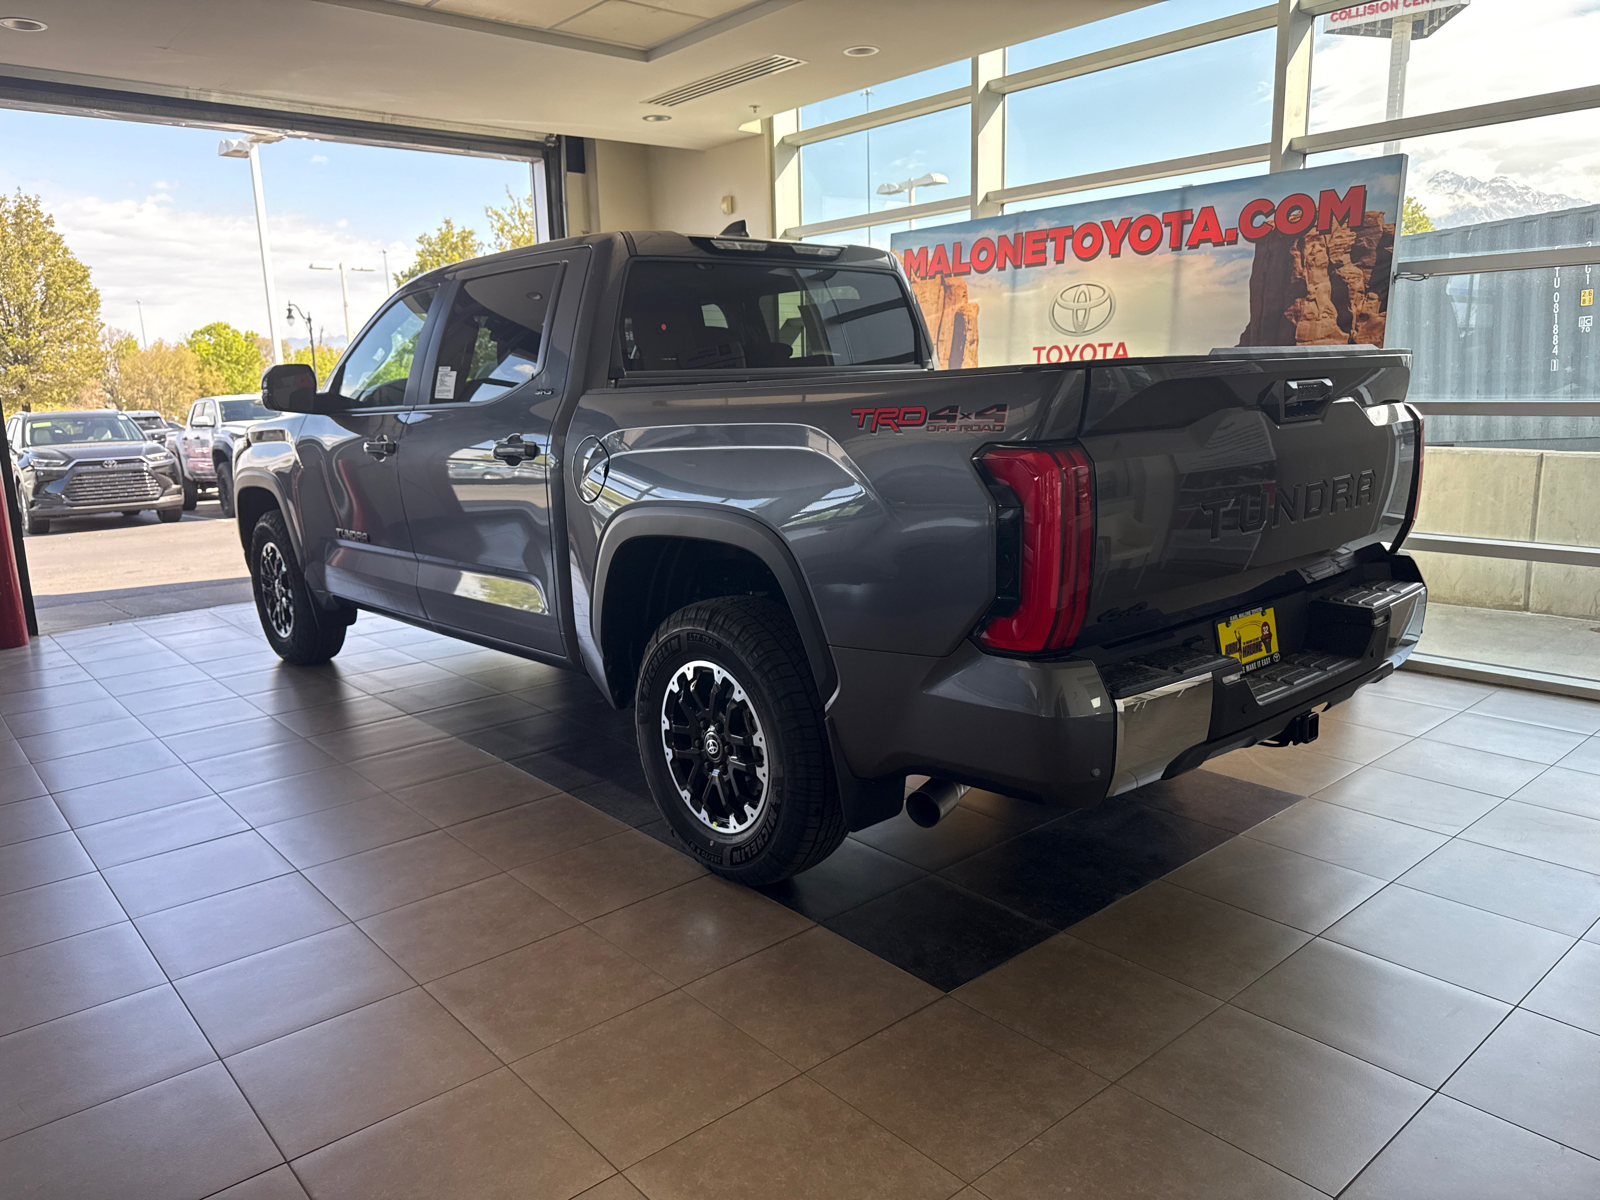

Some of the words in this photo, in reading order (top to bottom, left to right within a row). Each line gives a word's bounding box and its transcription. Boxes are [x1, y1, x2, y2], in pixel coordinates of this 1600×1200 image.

[1330, 0, 1399, 22] COLLISION
[904, 185, 1368, 280] MALONETOYOTA.COM
[1032, 342, 1128, 364] TOYOTA
[851, 405, 928, 436] TRD
[926, 424, 956, 433] OFF
[959, 424, 1005, 433] ROAD
[1199, 469, 1376, 542] TUNDRA
[335, 527, 371, 543] TUNDRA
[689, 633, 701, 643] LTX
[641, 637, 679, 699] MICHELIN
[731, 805, 778, 865] MICHELIN
